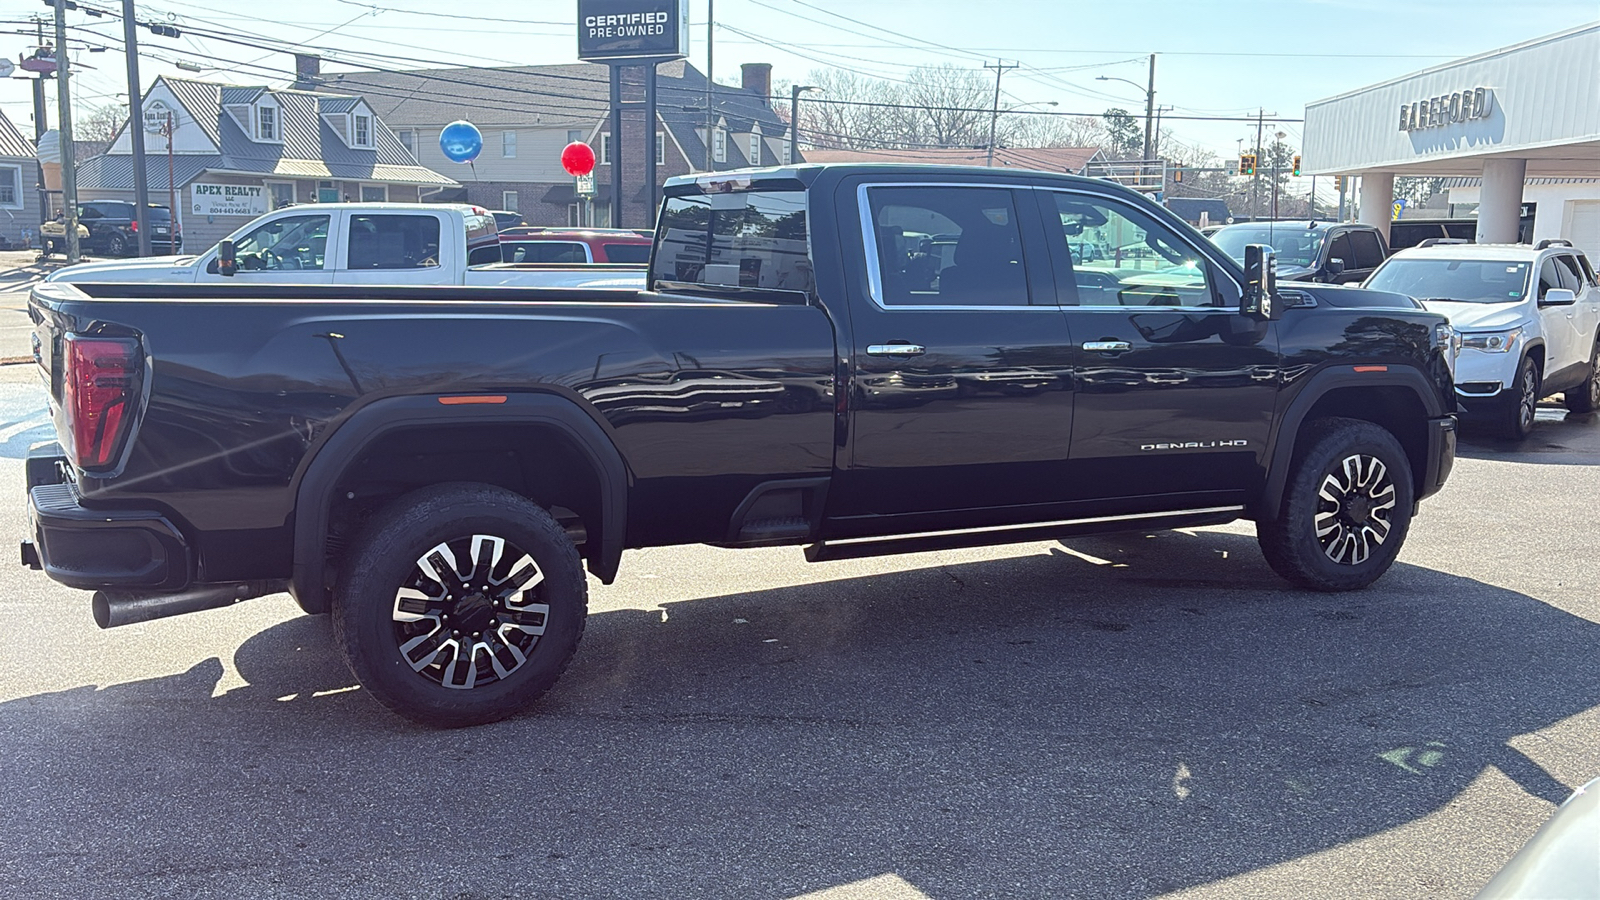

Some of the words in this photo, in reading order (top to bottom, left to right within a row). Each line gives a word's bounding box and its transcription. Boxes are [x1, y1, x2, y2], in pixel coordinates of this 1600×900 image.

[585, 11, 668, 27] CERTIFIED
[589, 24, 664, 38] PRE-OWNED
[1398, 86, 1493, 133] BAREFORD
[195, 184, 222, 196] APEX
[224, 186, 262, 197] REALTY
[1140, 441, 1216, 451] DENALI
[1219, 439, 1248, 447] HD
